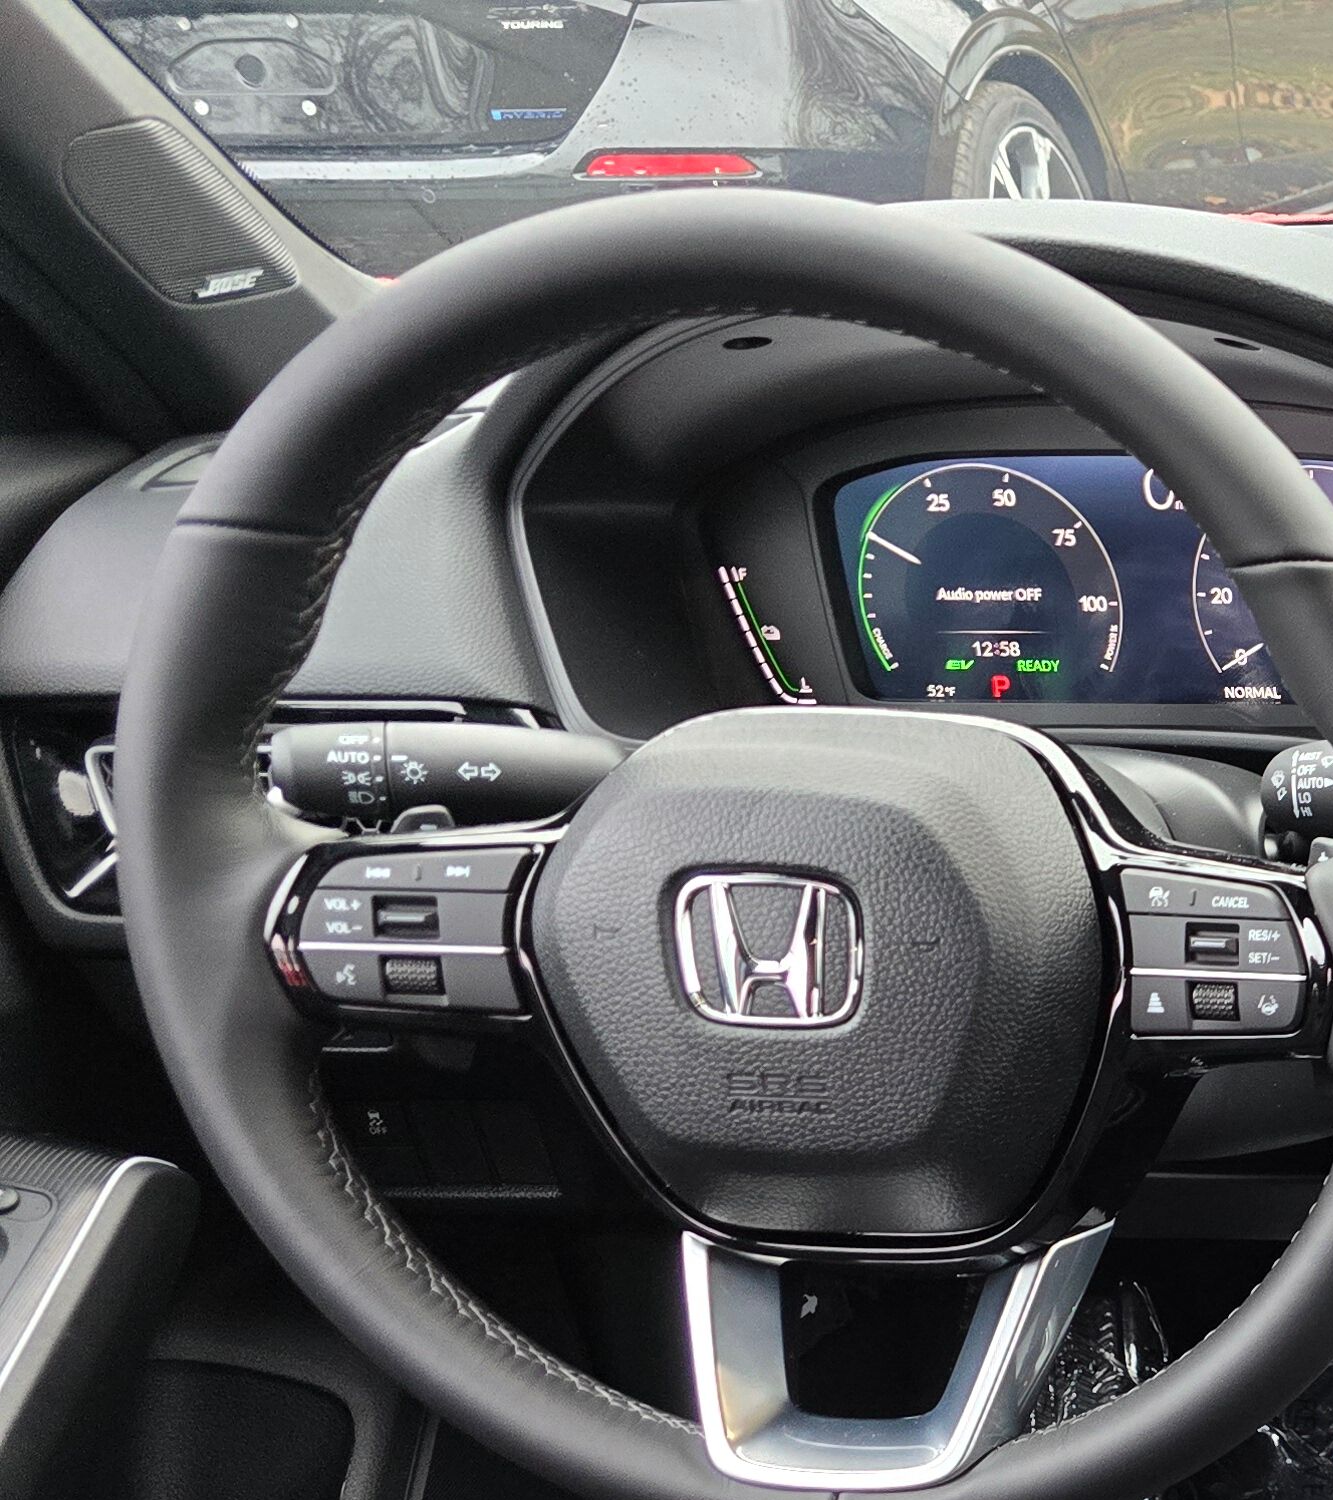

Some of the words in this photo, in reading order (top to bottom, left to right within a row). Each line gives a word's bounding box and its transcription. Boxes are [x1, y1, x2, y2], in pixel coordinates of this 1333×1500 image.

[501, 20, 564, 30] TOURING
[926, 494, 950, 512] 25
[992, 489, 1017, 507] 50
[1052, 528, 1077, 547] 75
[936, 587, 973, 601] Audio
[974, 589, 1014, 603] power
[1014, 588, 1042, 602] OFF
[1210, 587, 1233, 605] 20
[1078, 596, 1108, 612] 100
[971, 640, 1021, 658] 12:58
[945, 659, 975, 670] EV
[1016, 659, 1060, 672] READY
[926, 684, 956, 698] 52°F
[991, 675, 1011, 698] P
[1224, 686, 1282, 700] NORMAL
[327, 750, 370, 764] AUTO
[1297, 764, 1317, 776] OFF
[1297, 776, 1324, 790] AUTO
[1298, 792, 1312, 804] LO
[1300, 806, 1313, 817] HI
[1211, 896, 1250, 909] CANCEL
